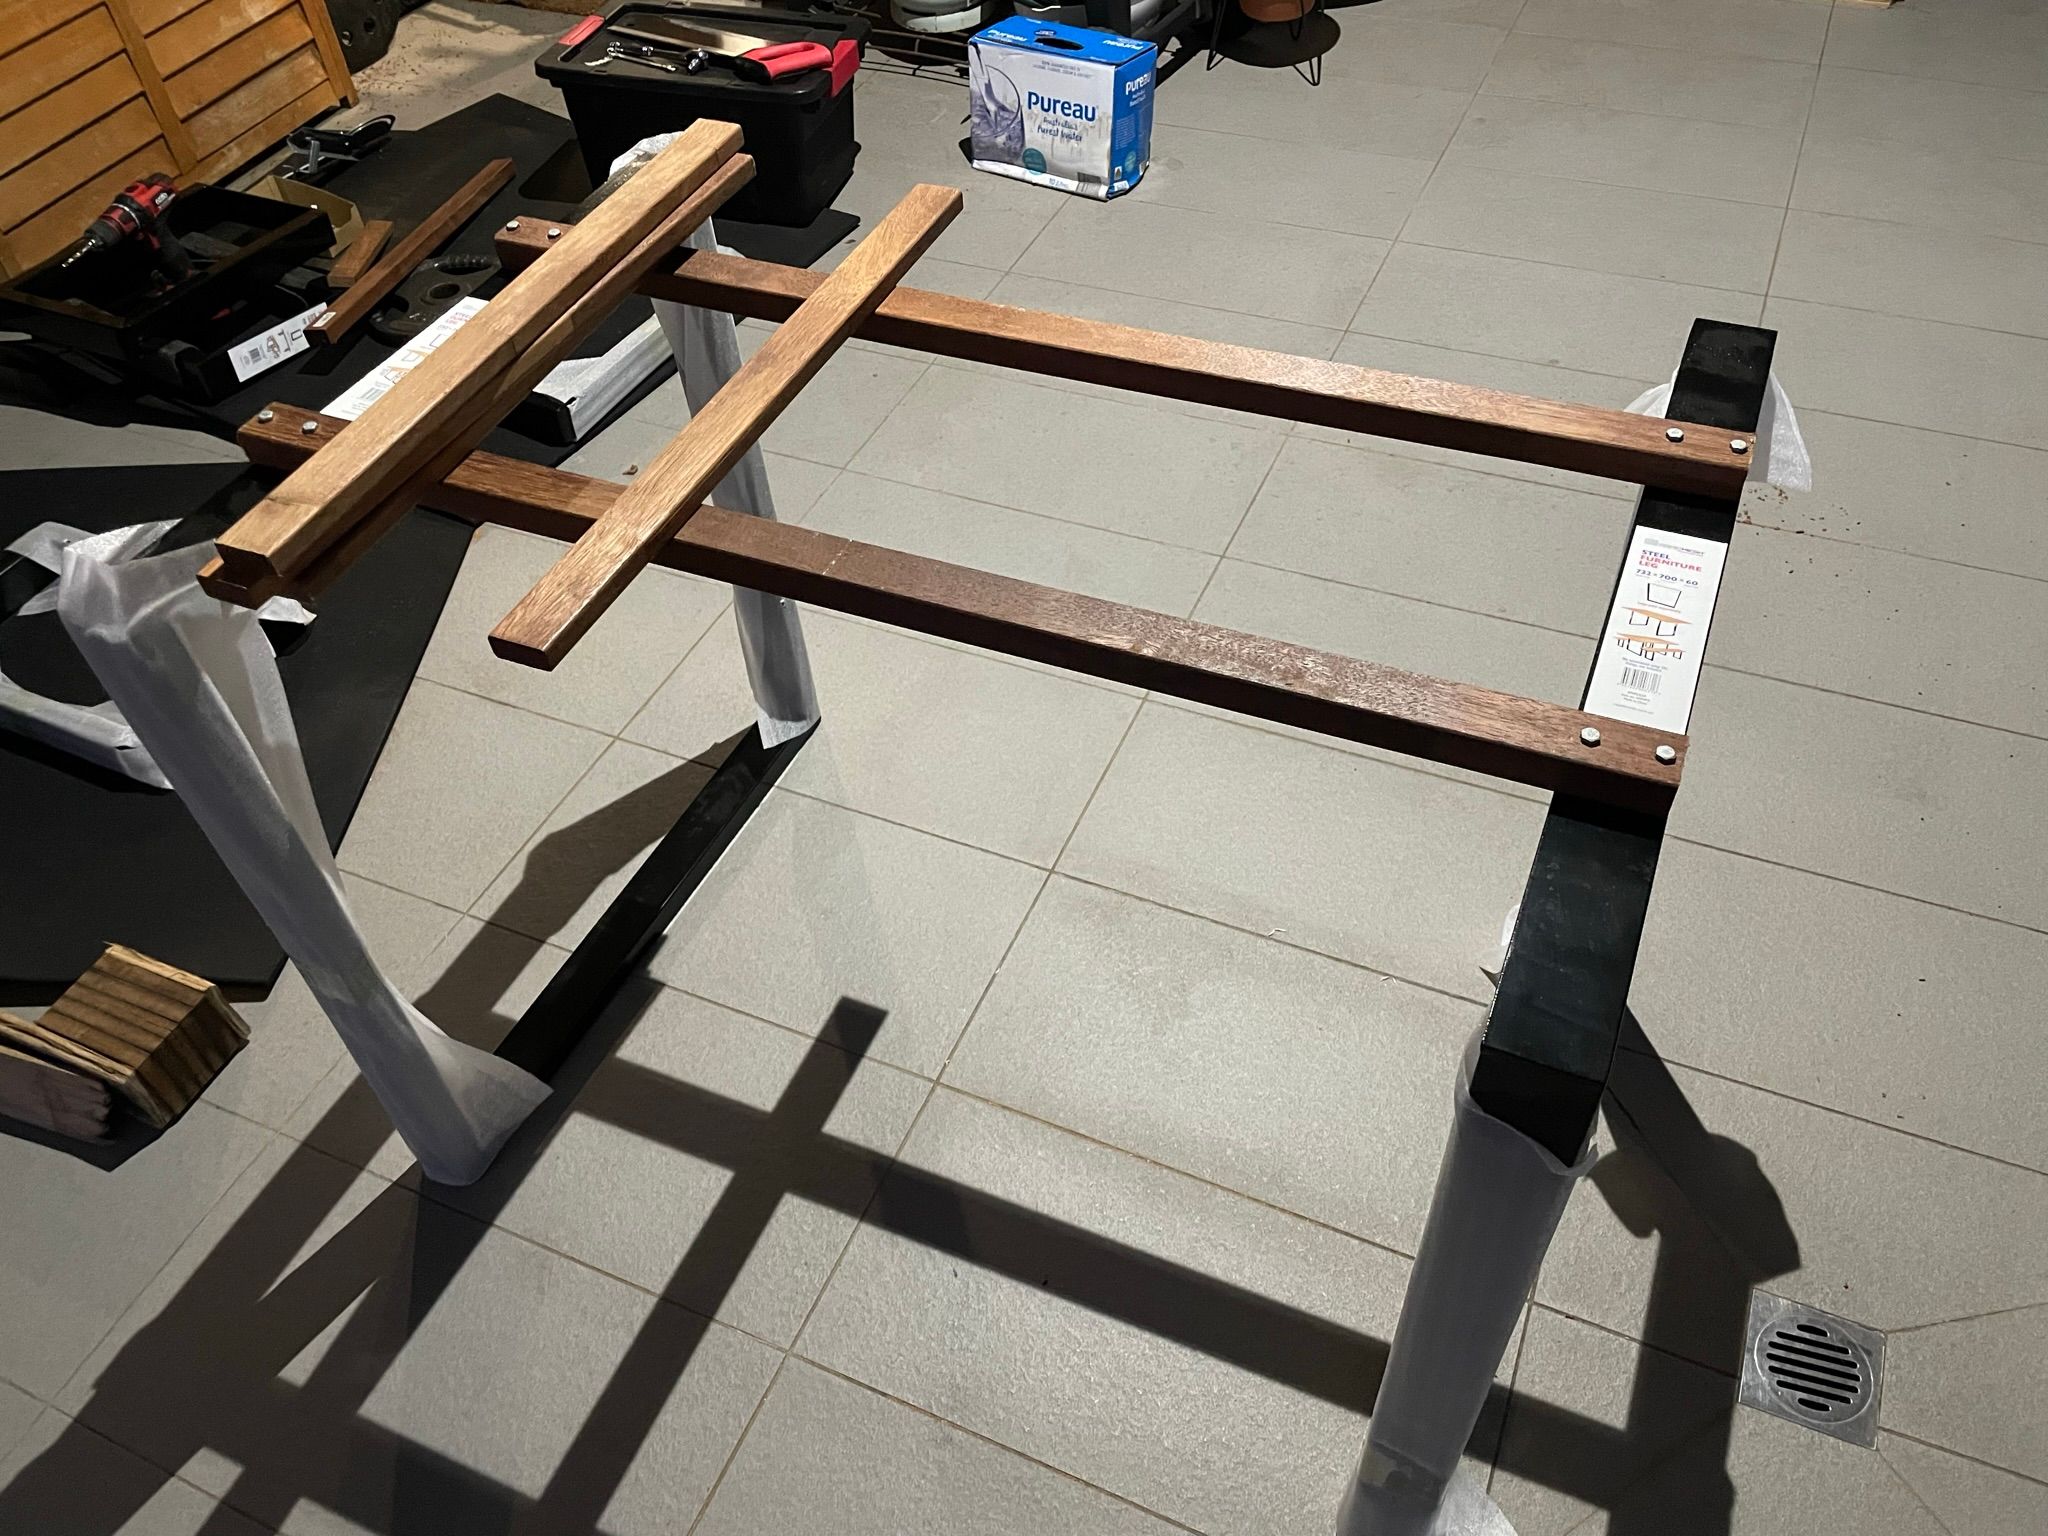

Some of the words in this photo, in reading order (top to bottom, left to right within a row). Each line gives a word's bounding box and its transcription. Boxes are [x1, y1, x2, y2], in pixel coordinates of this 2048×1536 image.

[1027, 90, 1096, 122] Pureau
[1642, 549, 1670, 560] STEEL
[1639, 560, 1658, 569] LEG
[1640, 555, 1702, 573] FURNITURE
[1659, 573, 1678, 582] 700
